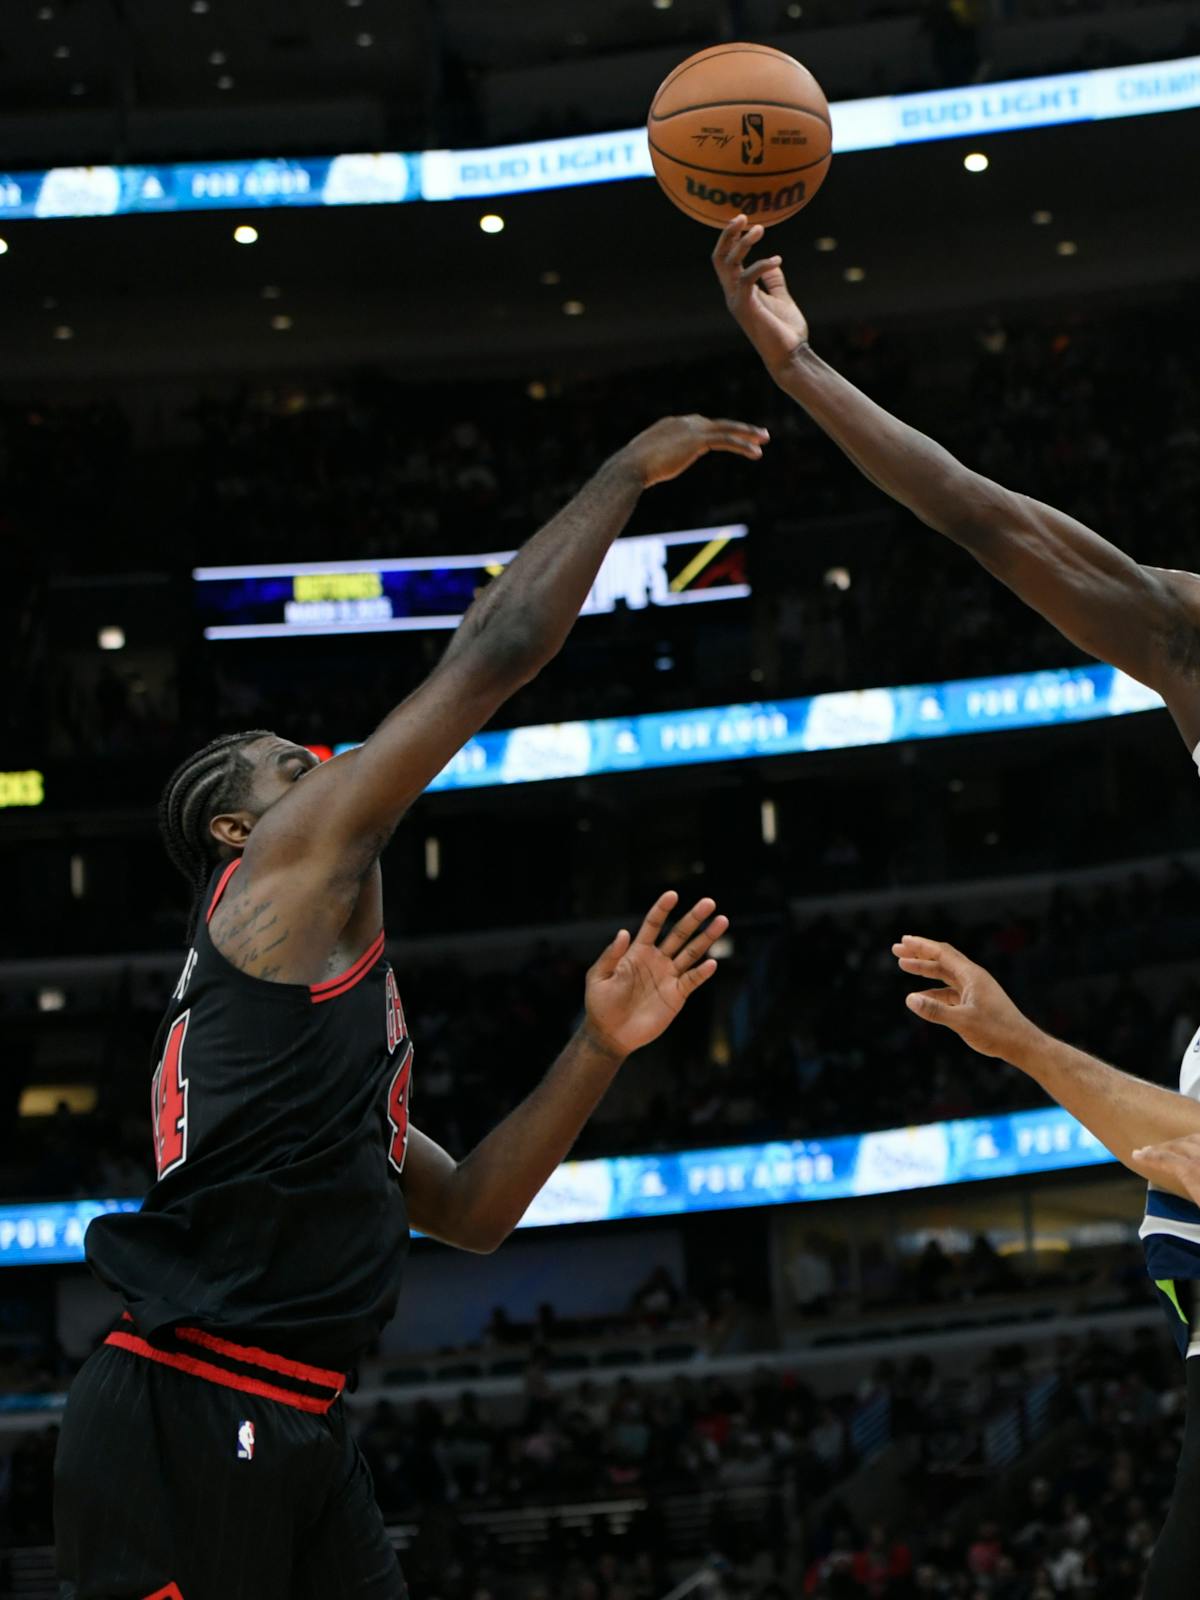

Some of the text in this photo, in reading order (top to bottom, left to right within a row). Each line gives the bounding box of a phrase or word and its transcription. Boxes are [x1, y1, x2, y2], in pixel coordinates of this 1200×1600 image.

[901, 86, 1080, 128] BUD LIGHT
[460, 143, 635, 183] BUD LIGHT
[685, 175, 806, 215] Wilson
[151, 1008, 189, 1182] 4
